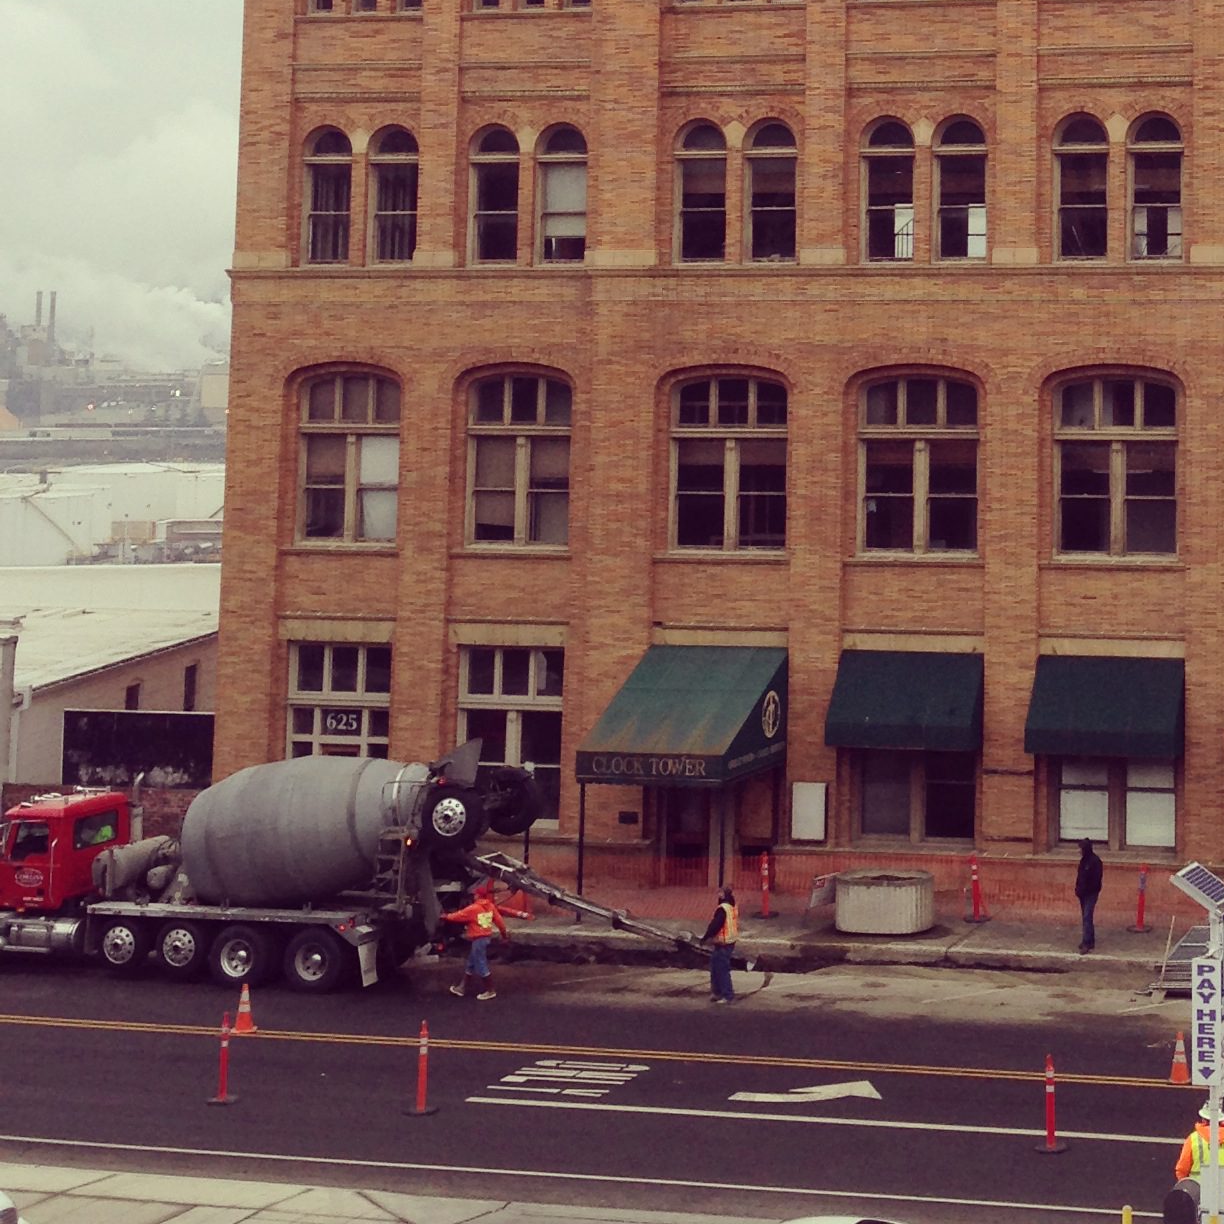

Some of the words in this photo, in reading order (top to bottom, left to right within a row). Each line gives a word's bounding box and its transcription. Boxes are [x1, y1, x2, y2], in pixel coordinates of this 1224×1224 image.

[326, 713, 358, 730] 625
[592, 755, 644, 774] CLOCK
[649, 757, 706, 776] TOWER
[1196, 964, 1216, 1004] PAY
[1196, 1009, 1216, 1063] HERE
